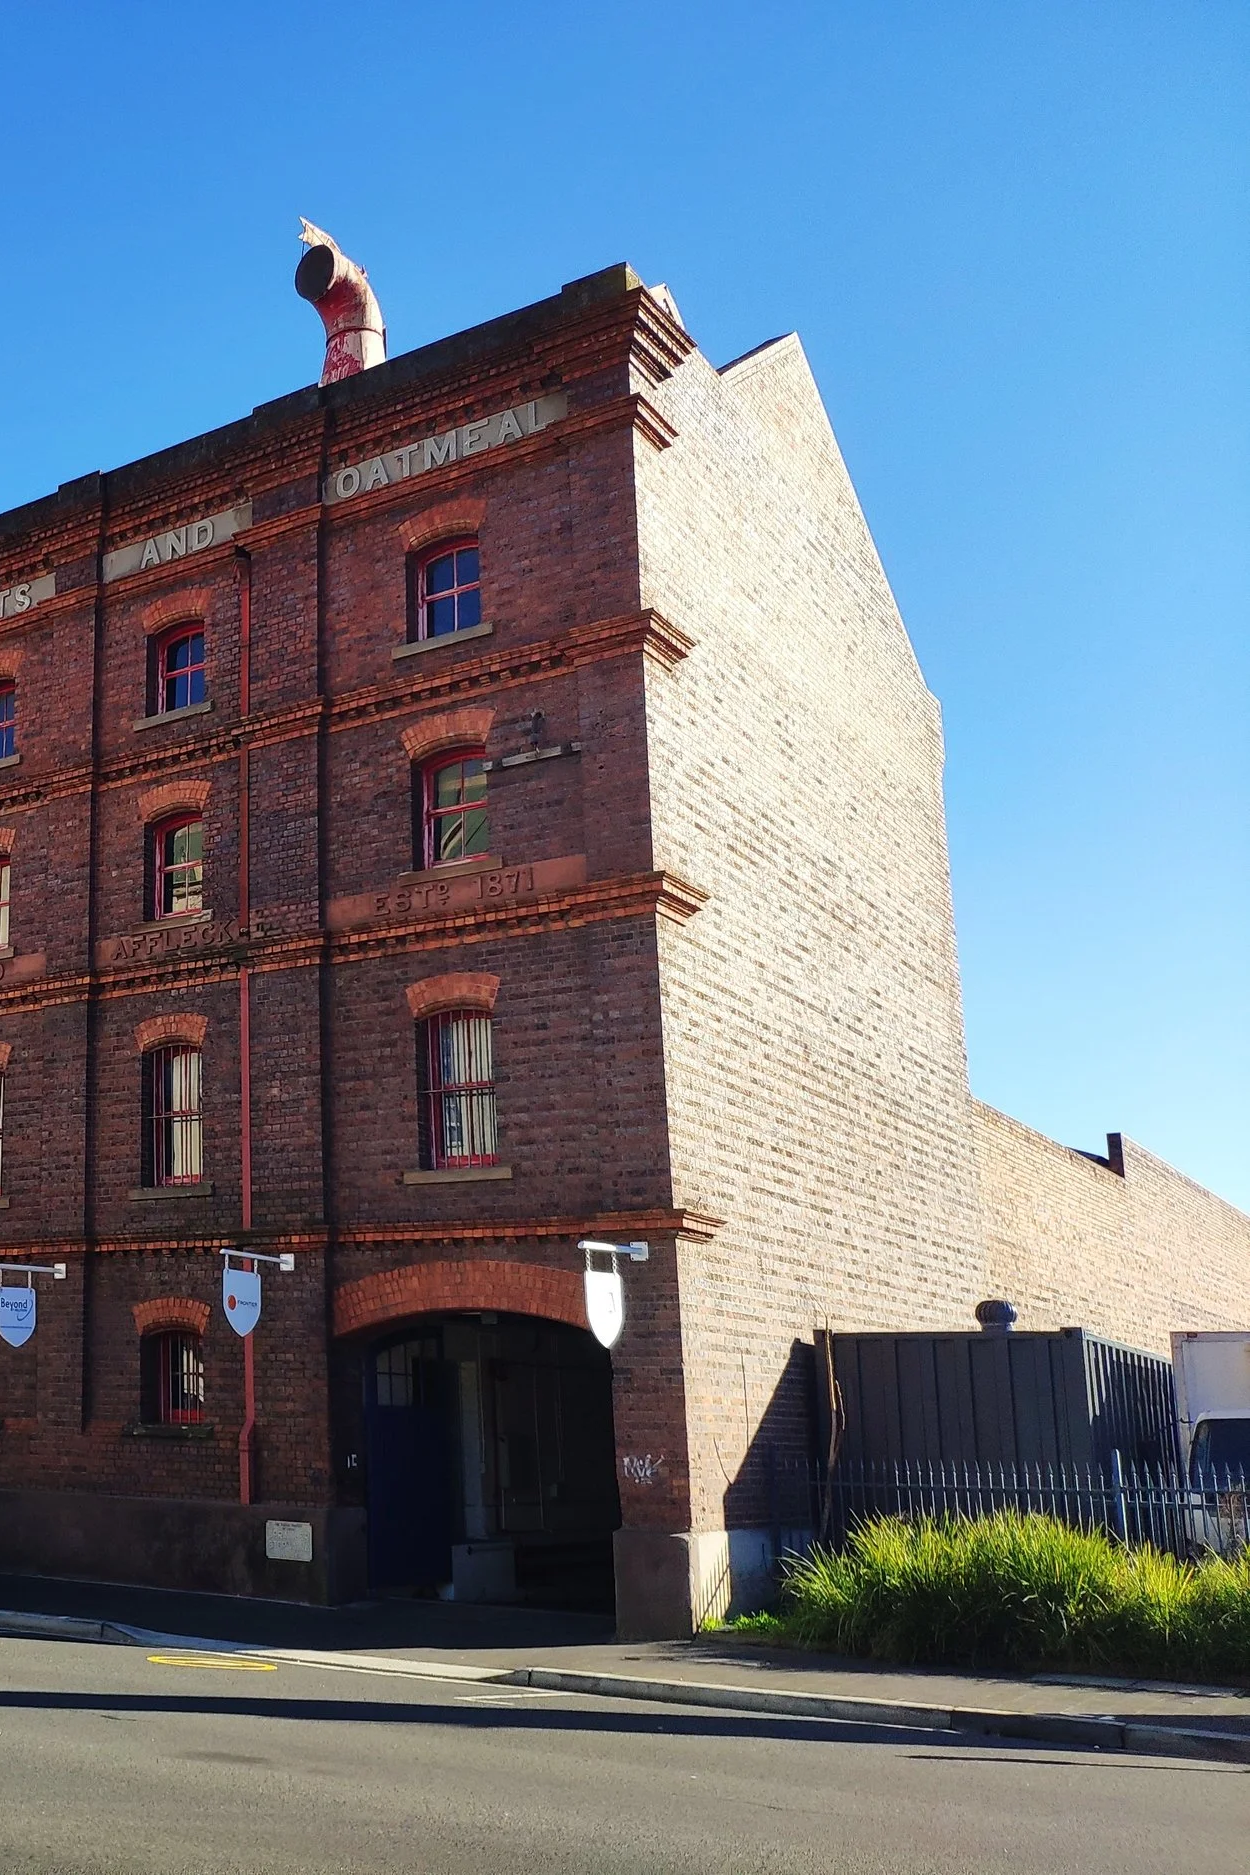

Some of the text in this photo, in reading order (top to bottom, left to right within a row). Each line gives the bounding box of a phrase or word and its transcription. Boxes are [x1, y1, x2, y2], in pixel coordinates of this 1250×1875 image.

[140, 519, 215, 569] AND
[335, 400, 549, 498] OATMEAL
[473, 867, 535, 900] 1871
[112, 920, 235, 960] AFFLECK
[0, 1297, 28, 1312] Beyond
